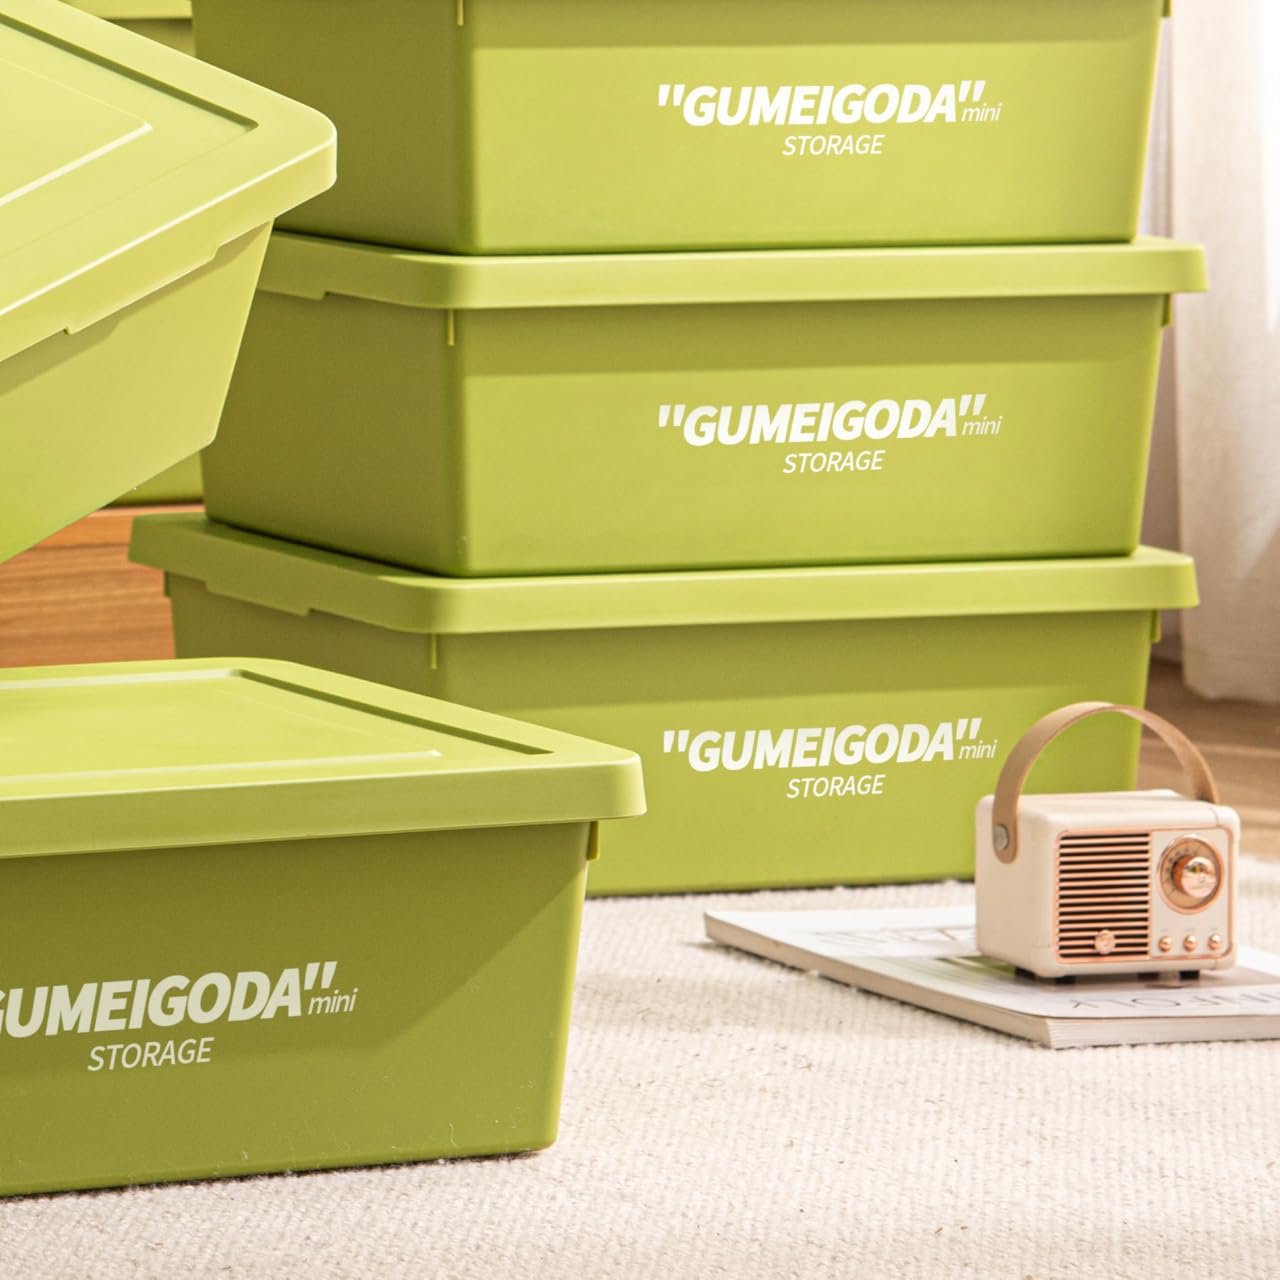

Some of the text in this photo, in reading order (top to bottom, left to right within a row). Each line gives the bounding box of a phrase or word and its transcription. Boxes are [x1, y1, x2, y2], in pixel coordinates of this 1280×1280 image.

[657, 79, 1003, 127] "GUMEIGODA" mini
[781, 133, 887, 157] STORAGE
[657, 392, 1004, 448] "GUMEIGODA" mini
[782, 449, 887, 475] STORAGE
[662, 716, 999, 773] "GUMEIGODA" mini
[785, 773, 887, 800] STORAGE
[306, 986, 359, 1017] mini
[87, 1036, 215, 1072] STORAGE
